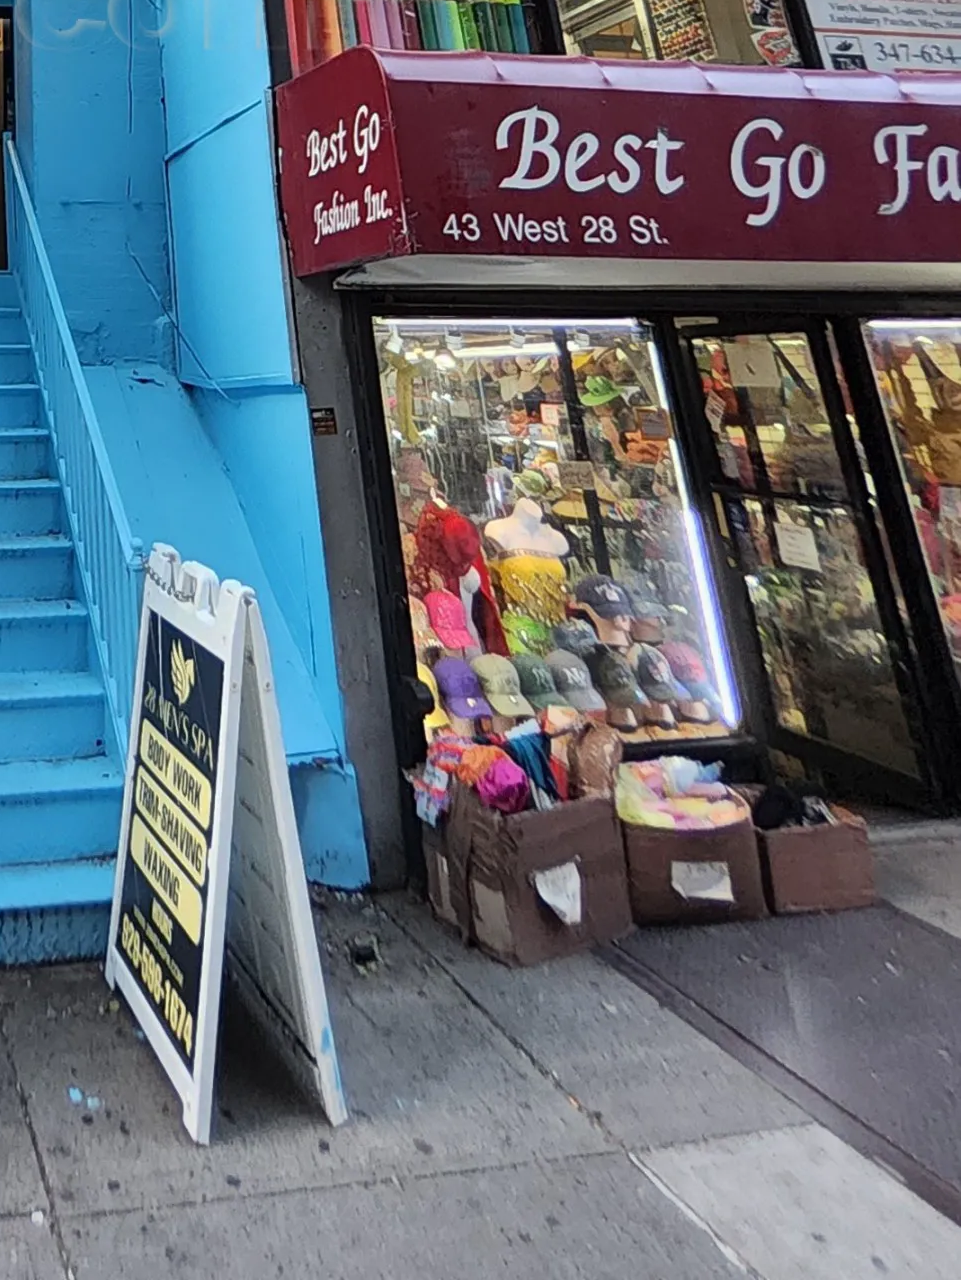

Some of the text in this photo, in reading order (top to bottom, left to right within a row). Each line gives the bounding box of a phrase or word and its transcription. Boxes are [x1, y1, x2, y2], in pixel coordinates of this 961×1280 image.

[306, 104, 380, 177] Best Go
[495, 106, 685, 194] Best
[730, 117, 826, 227] Go
[314, 184, 393, 245] Fashion Inc.
[441, 211, 670, 246] 43 West 28 St.
[147, 732, 202, 812] BODY WORK
[190, 722, 213, 771] SPA
[138, 775, 203, 874] TRIM-SHAVING
[143, 837, 180, 909] WAXING
